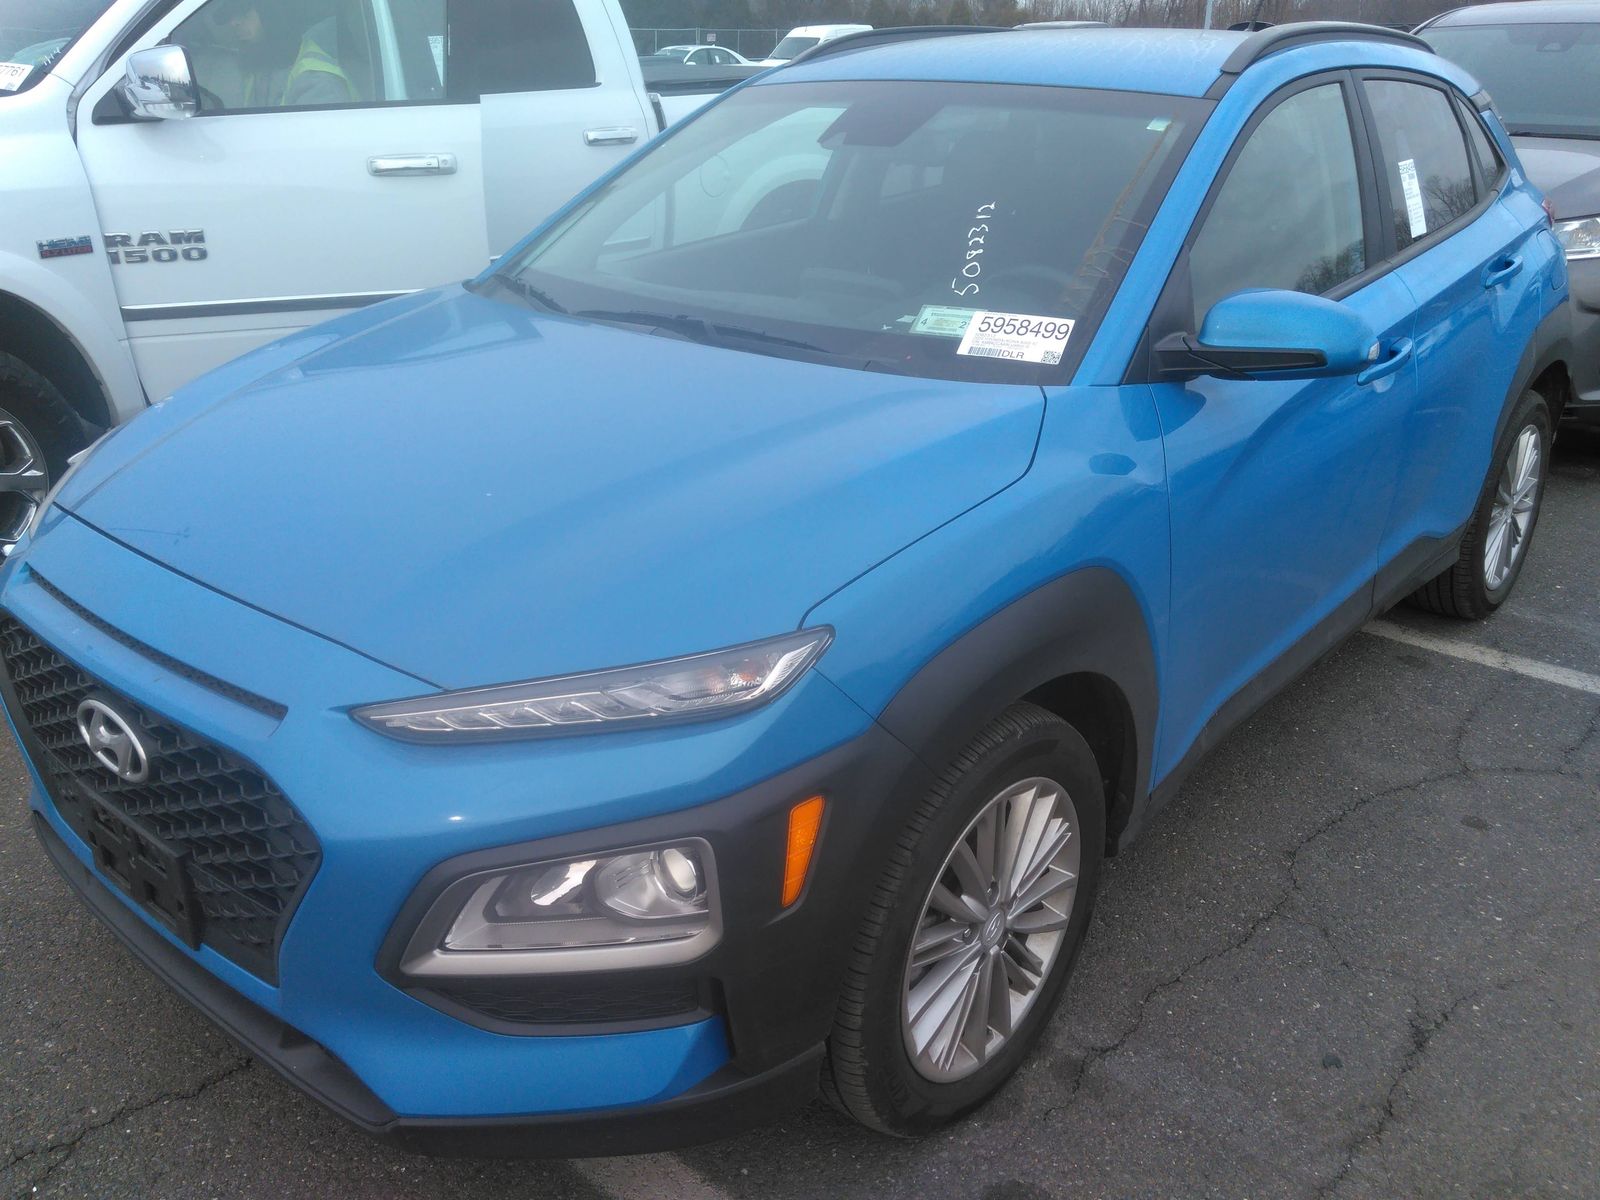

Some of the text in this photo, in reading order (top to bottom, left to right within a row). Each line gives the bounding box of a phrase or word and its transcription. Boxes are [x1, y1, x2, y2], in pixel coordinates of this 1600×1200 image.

[104, 230, 205, 248] RAM
[106, 246, 208, 264] 1500
[978, 316, 1070, 340] 5958499
[1001, 349, 1025, 359] DLR
